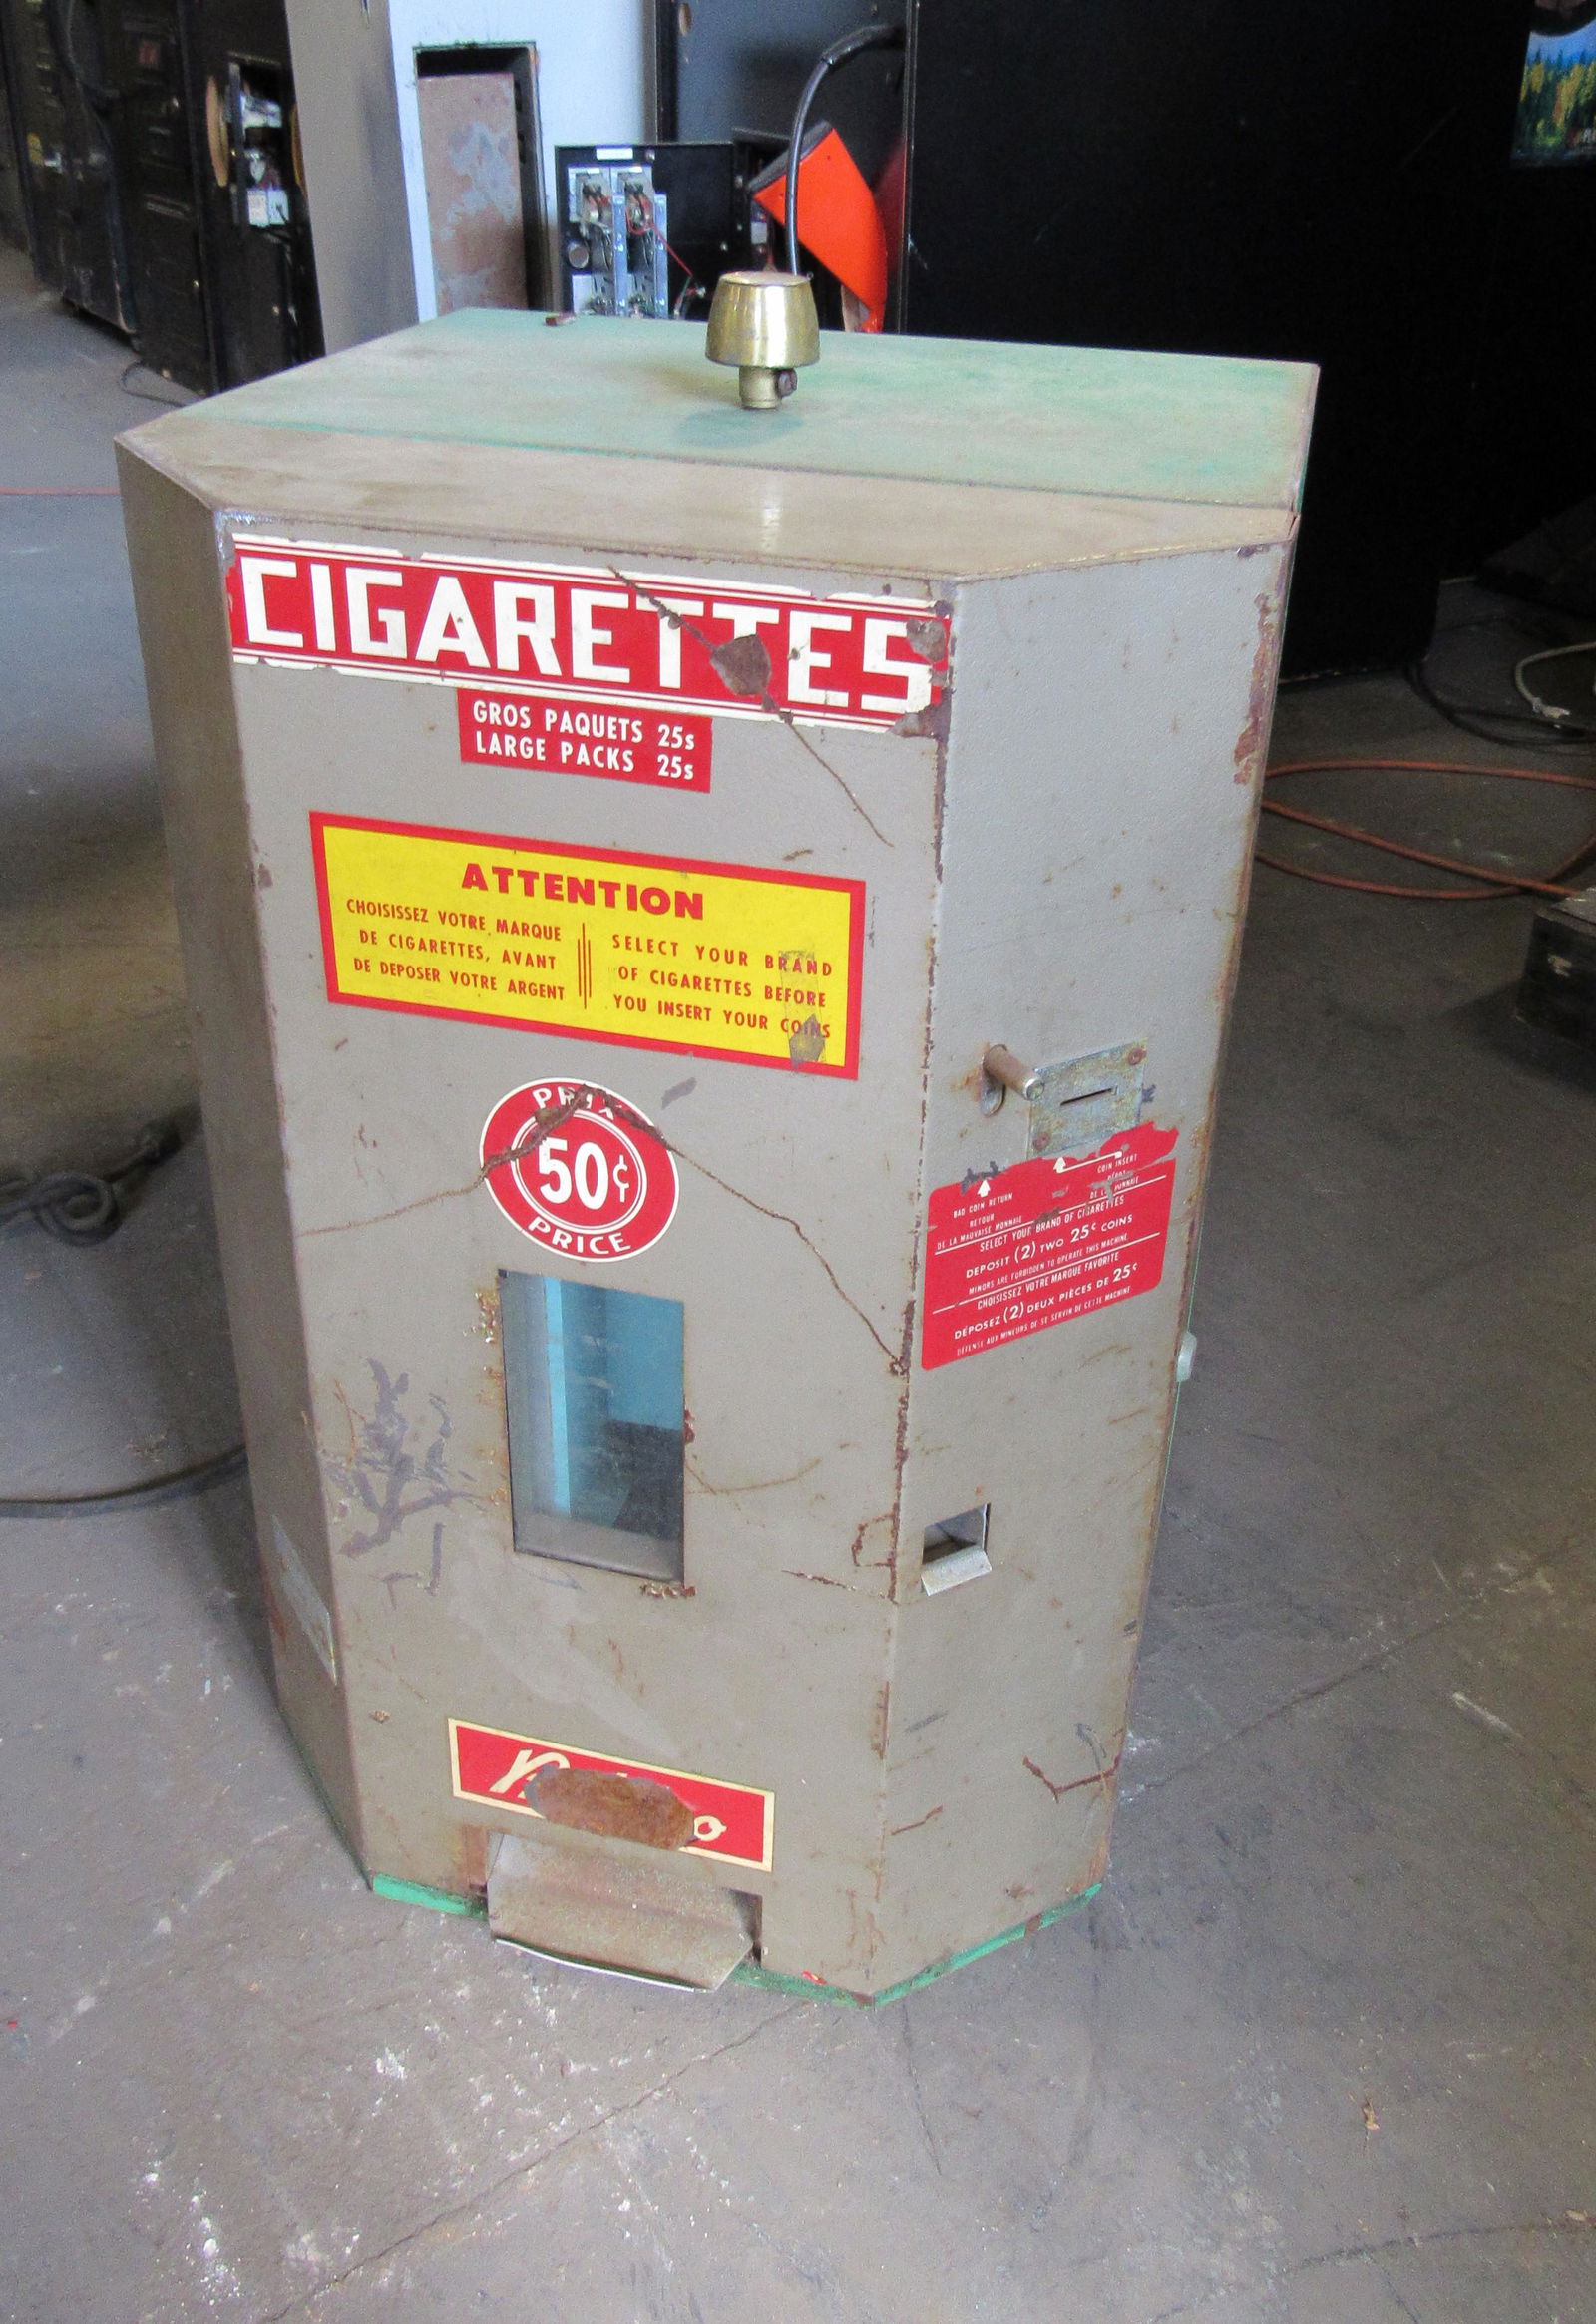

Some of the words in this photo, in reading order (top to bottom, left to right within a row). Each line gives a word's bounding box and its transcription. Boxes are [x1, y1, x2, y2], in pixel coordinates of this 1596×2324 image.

[239, 556, 935, 713] CIGARETTES
[473, 699, 532, 729] GROS
[545, 708, 643, 743] PAQUETS
[657, 723, 695, 750] 25s
[475, 730, 546, 761] LARGE
[561, 741, 634, 772] PACKS
[656, 754, 694, 780] 25s
[462, 863, 703, 920] ATTENTION
[346, 899, 429, 924] CHOISISSEZ
[438, 910, 486, 931] VOTRE
[496, 919, 562, 941] MARQUE
[359, 929, 378, 945] DE
[388, 934, 491, 962] CIGARETTES,
[502, 949, 557, 970] AVANT
[611, 934, 679, 957] SELECT
[695, 945, 749, 967] YOUR
[764, 955, 832, 977] BRAND
[353, 958, 371, 973] DE
[380, 961, 441, 982] DEPOSER
[449, 970, 498, 991] VOTRE
[507, 979, 566, 1001] ARGENT
[617, 966, 638, 981] OF
[649, 969, 752, 997] CIGARETTES
[764, 985, 827, 1008] BEFORE
[612, 994, 647, 1012] YOU
[657, 1000, 712, 1022] INSERT
[722, 1009, 769, 1030] YOUR
[538, 1135, 630, 1210] 50¢
[1097, 1162, 1112, 1174] COIN
[1115, 1153, 1137, 1167] INSERT
[953, 1208, 966, 1219] BAD
[969, 1202, 985, 1213] COIN
[989, 1192, 1013, 1206] RETURN
[527, 1216, 631, 1255] PRICE
[960, 1227, 992, 1242] MAUVAISE
[966, 1256, 1010, 1279] DEPOSIT
[1014, 1240, 1036, 1264] (2)
[1040, 1238, 1064, 1254] TWO
[1100, 1214, 1133, 1232] COINS
[980, 1235, 1008, 1252] SELECT
[1036, 1216, 1061, 1234] BRAND
[1064, 1212, 1074, 1224] OF
[969, 1281, 995, 1295] MINORS
[997, 1275, 1008, 1287] ARE
[1010, 1263, 1045, 1283] FORBIDDEN
[1047, 1259, 1055, 1268] TO
[1056, 1248, 1083, 1265] OPERATE
[1086, 1243, 1099, 1254] THIS
[1101, 1233, 1128, 1250] MACHINE
[977, 1286, 1022, 1311] CHOISISSEZ
[1025, 1278, 1049, 1294] VOTRE
[1050, 1265, 1082, 1285] MARQUE
[1084, 1252, 1119, 1273] FAVORITE
[1003, 1301, 1024, 1324] (2)
[1027, 1297, 1055, 1314] DEUX
[1059, 1283, 1093, 1302] PIÈCES
[1096, 1277, 1110, 1289] DE
[1104, 1285, 1131, 1302] MACHINE
